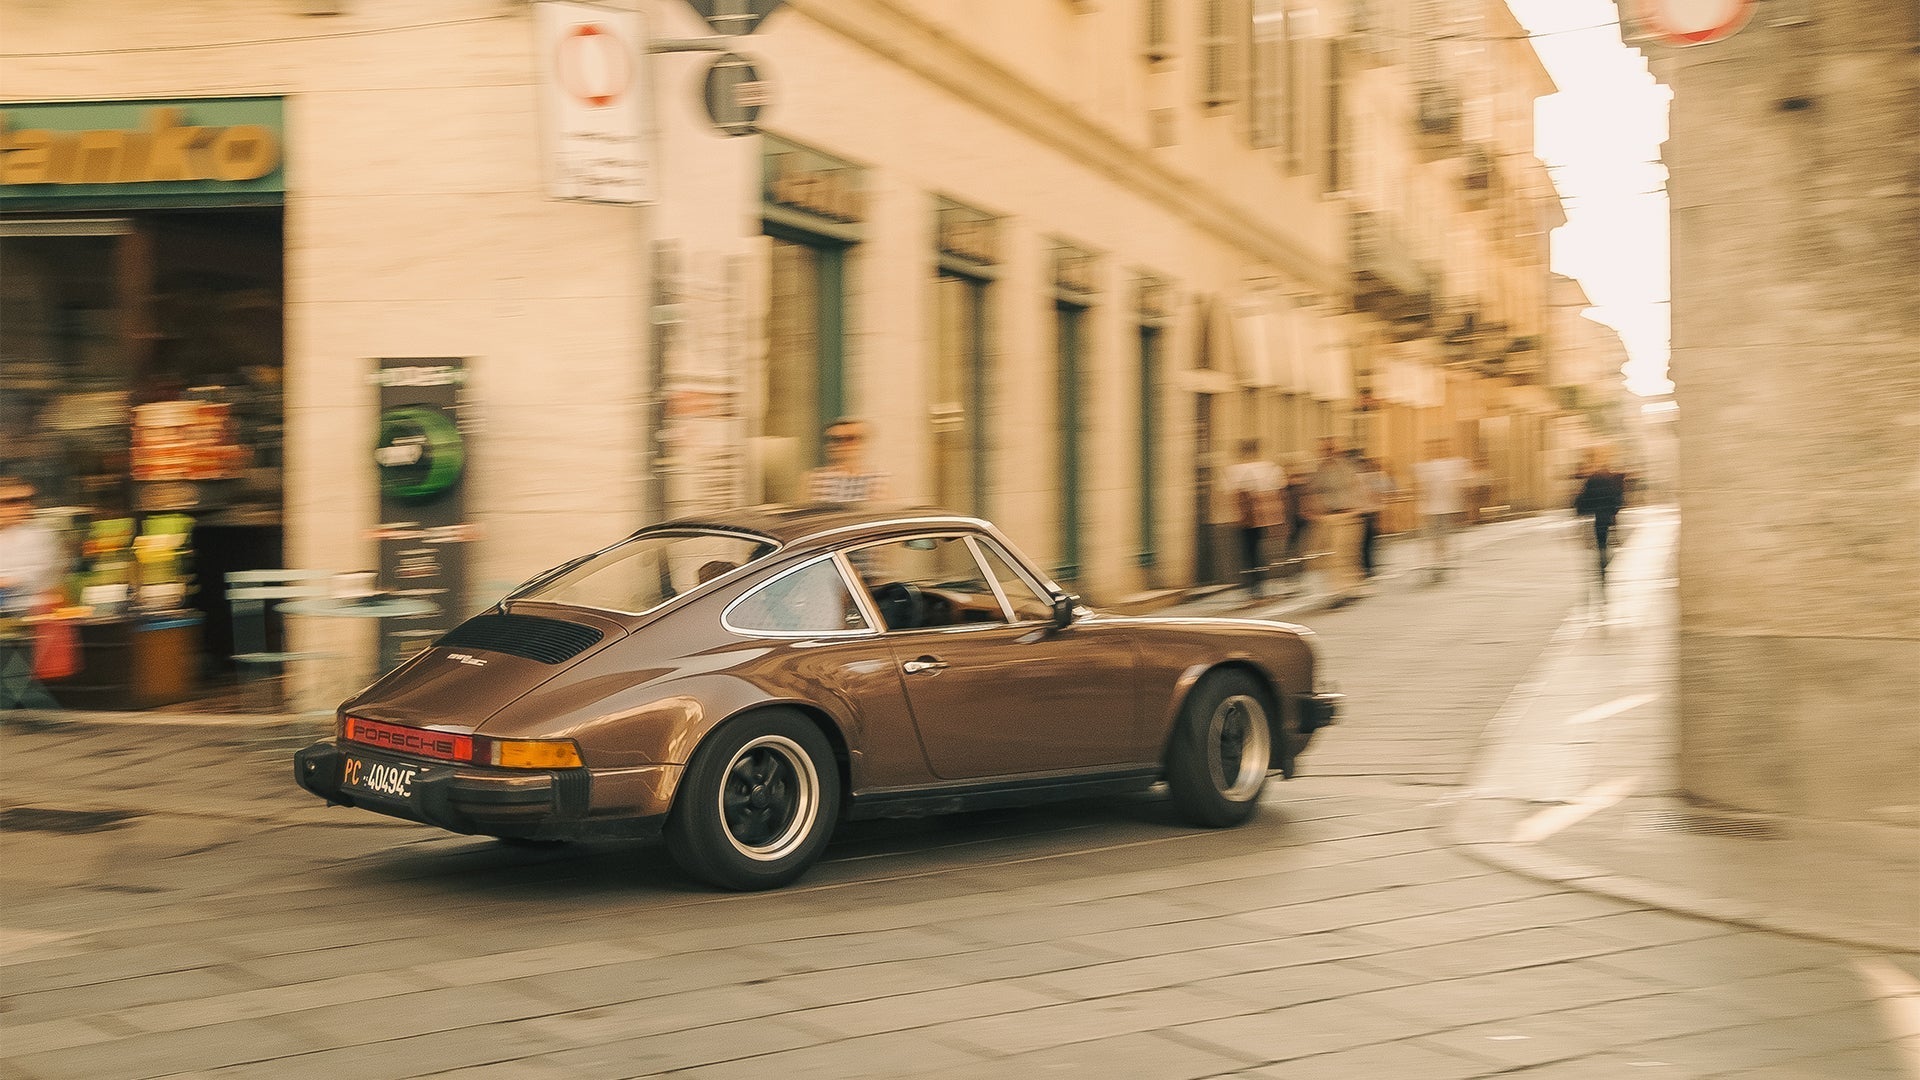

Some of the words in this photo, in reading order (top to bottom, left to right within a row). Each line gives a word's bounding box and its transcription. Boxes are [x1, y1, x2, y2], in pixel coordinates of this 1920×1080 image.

[0, 107, 278, 184] anko
[354, 725, 453, 753] PORSCHE
[344, 758, 362, 785] PC
